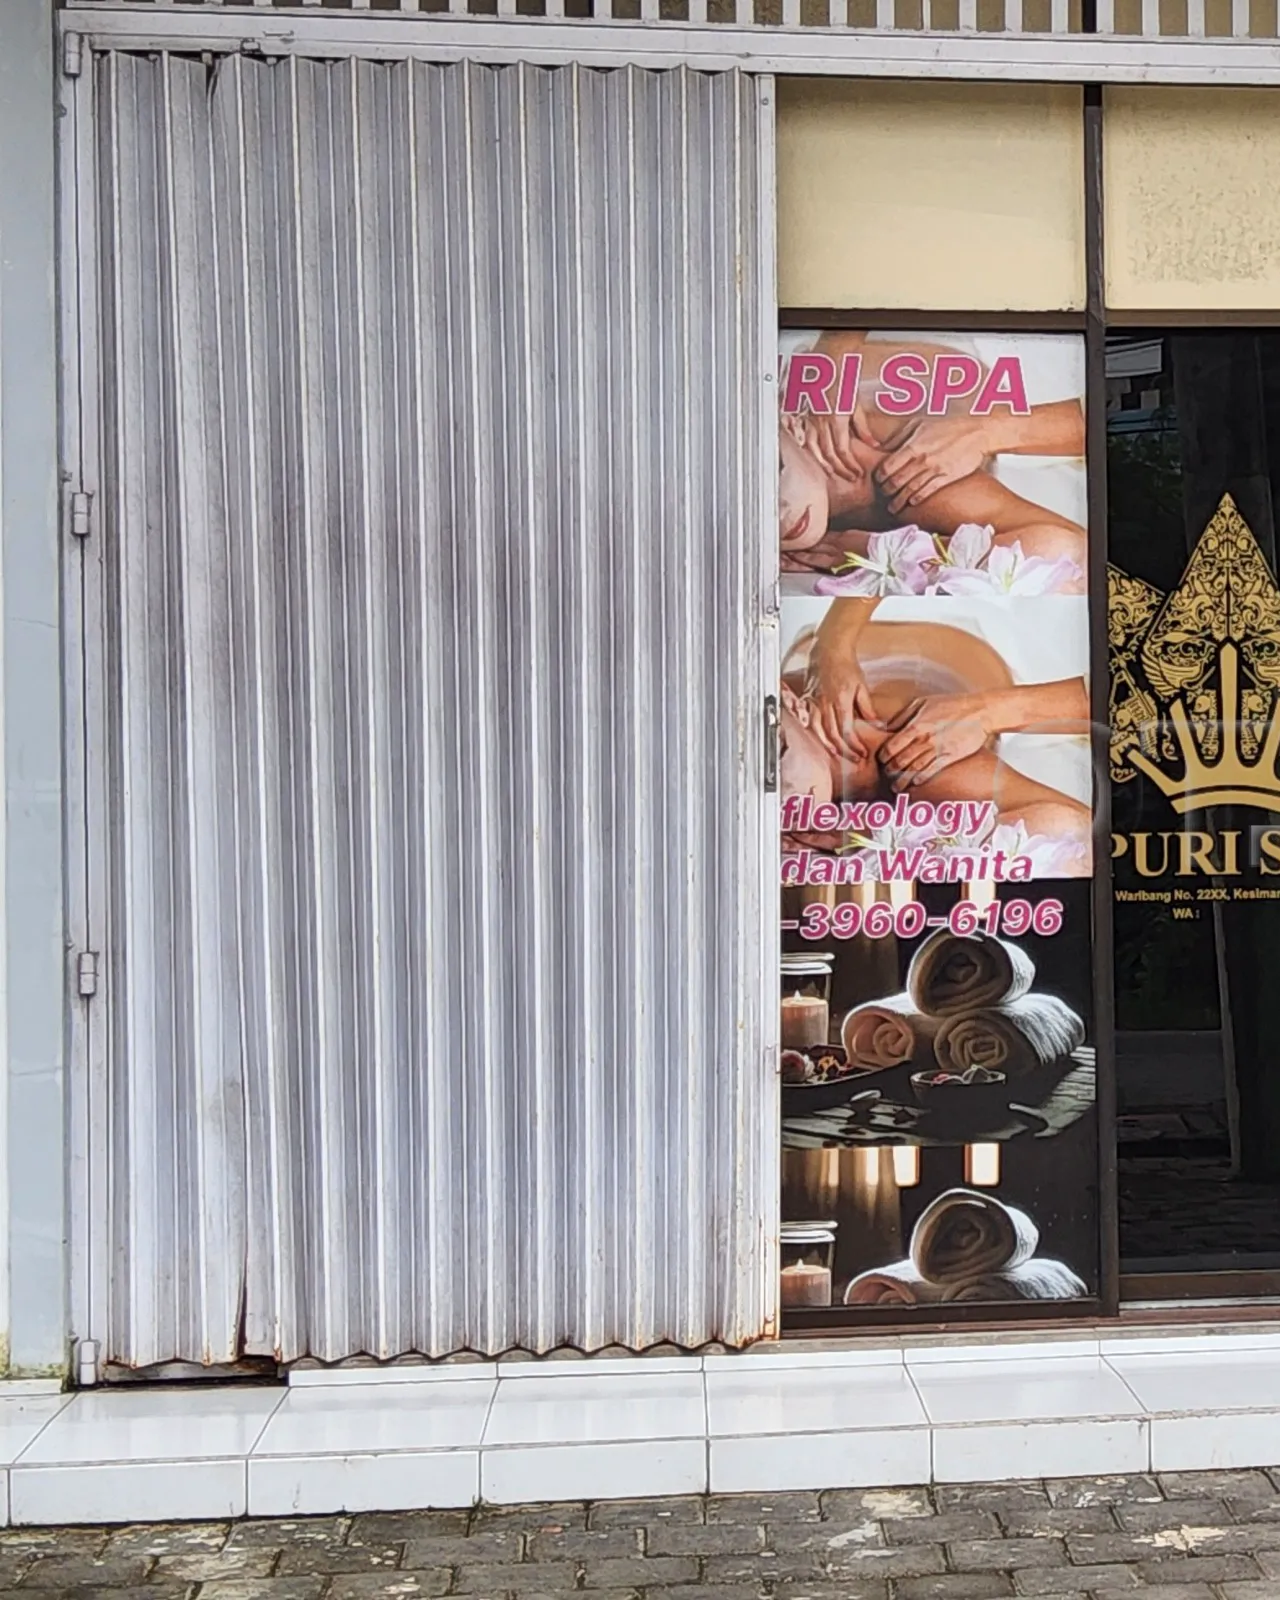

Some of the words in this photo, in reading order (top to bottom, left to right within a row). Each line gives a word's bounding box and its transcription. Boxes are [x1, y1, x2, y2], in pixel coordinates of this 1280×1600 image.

[875, 353, 1032, 416] SPA
[781, 850, 865, 885] dan
[878, 844, 1034, 884] Wanita
[1115, 890, 1171, 903] Waribang
[1172, 907, 1194, 920] WA
